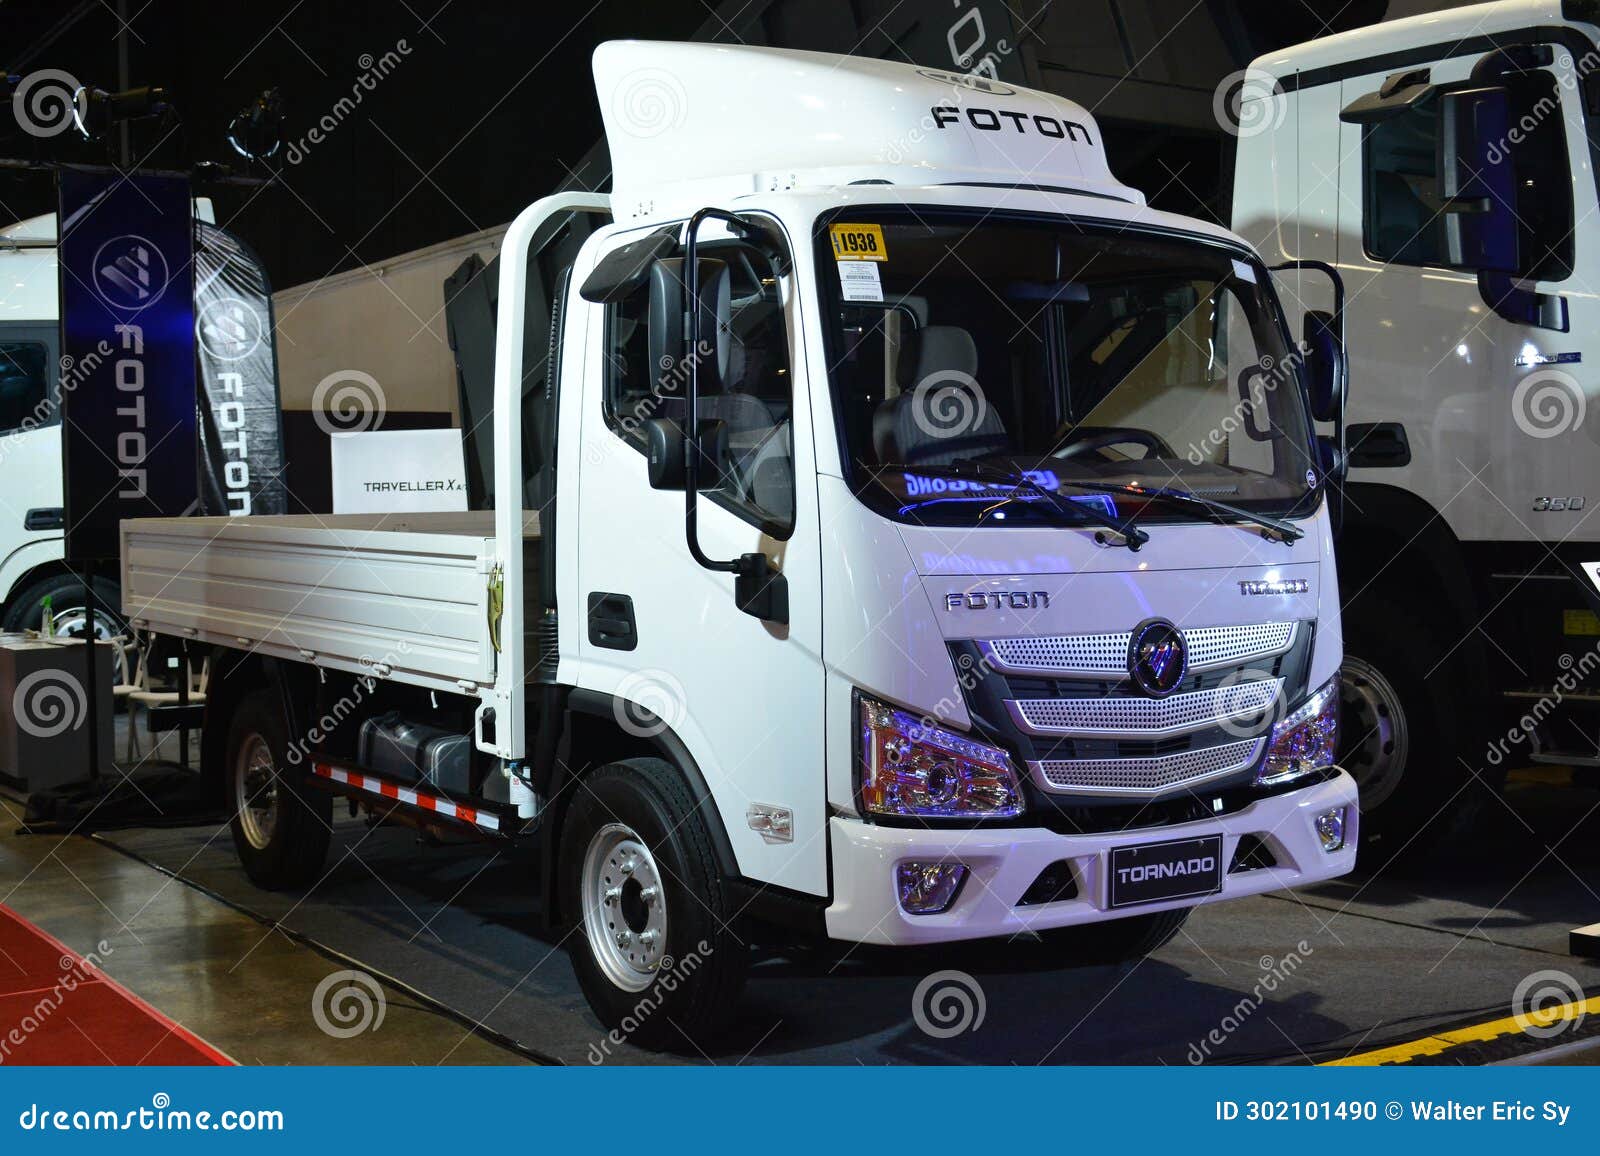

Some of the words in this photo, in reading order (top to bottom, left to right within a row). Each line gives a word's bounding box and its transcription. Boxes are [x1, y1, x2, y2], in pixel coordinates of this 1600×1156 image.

[931, 106, 1093, 146] FOTON
[841, 232, 877, 252] 1938
[114, 324, 147, 499] FOTON
[217, 372, 251, 517] FOTON
[364, 481, 444, 492] TRAVELLER
[446, 479, 457, 491] X
[1533, 496, 1585, 511] 350
[1237, 579, 1309, 595] TODO
[944, 591, 1050, 610] FOTON
[1118, 856, 1215, 884] TORNADO
